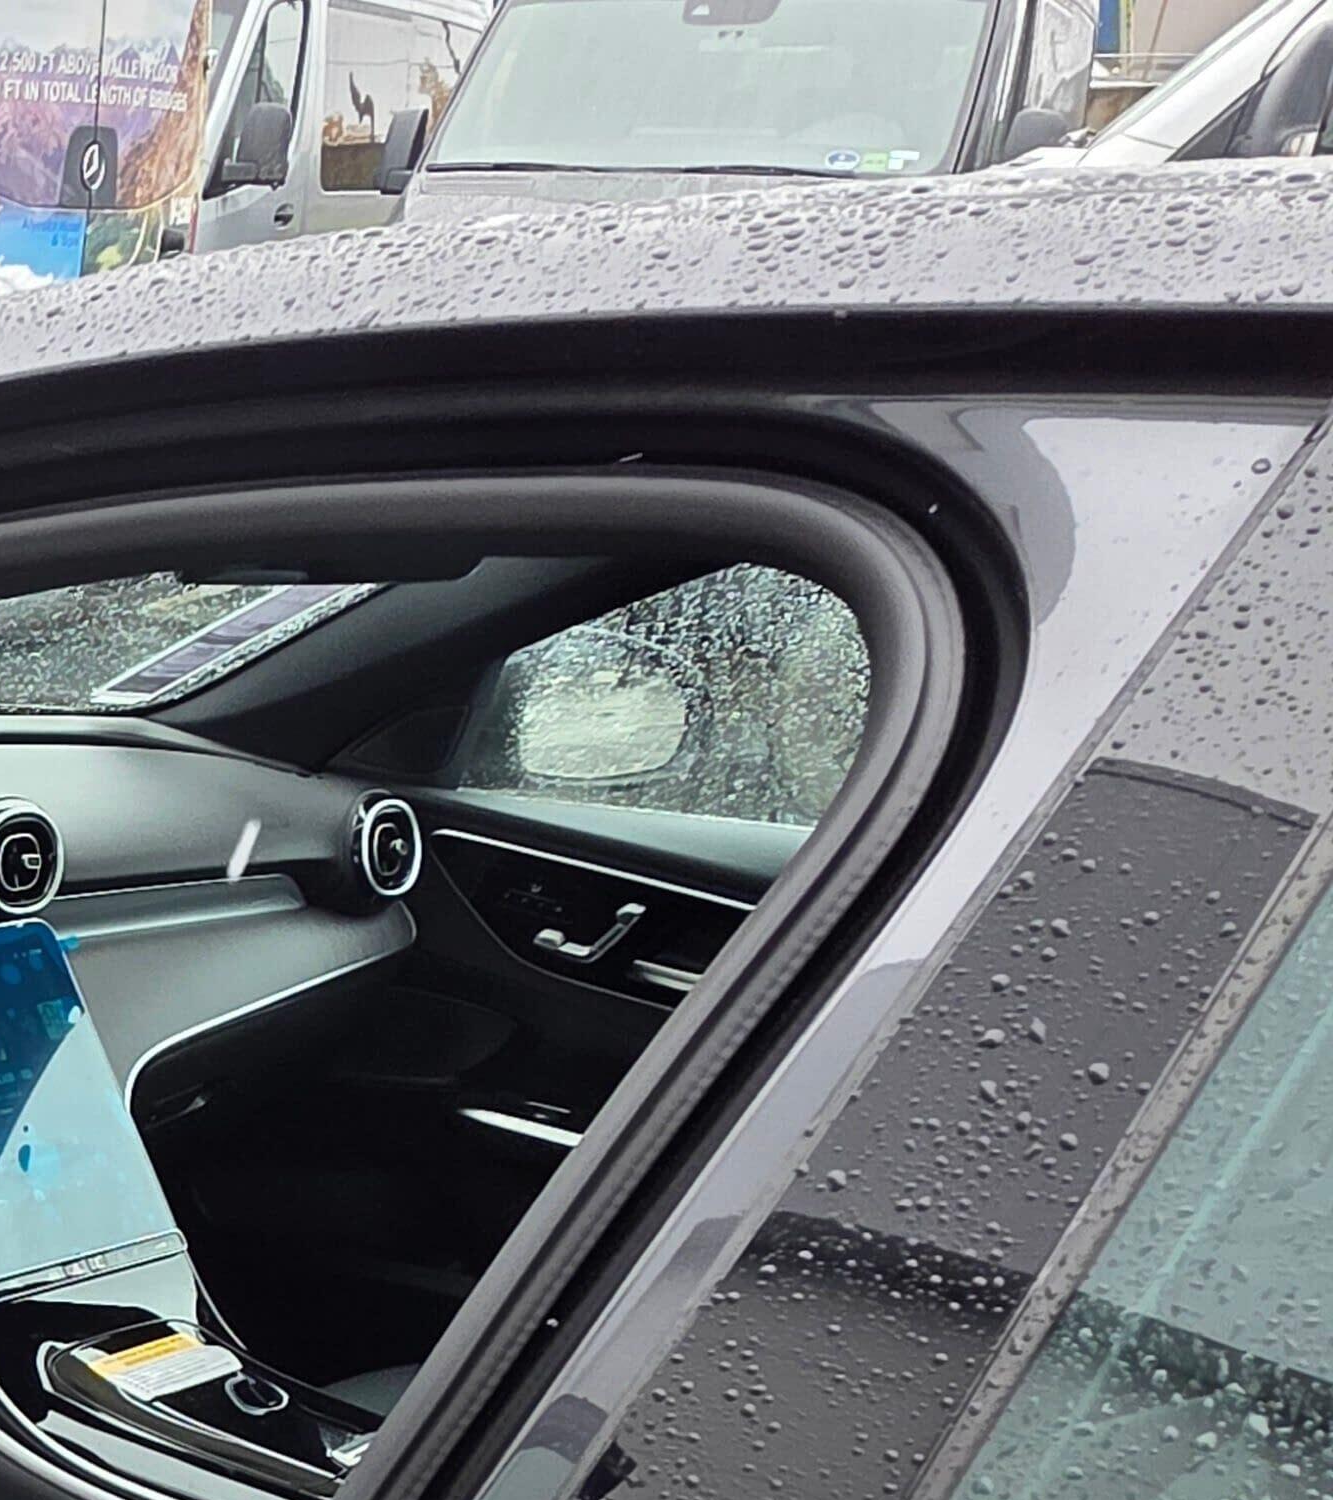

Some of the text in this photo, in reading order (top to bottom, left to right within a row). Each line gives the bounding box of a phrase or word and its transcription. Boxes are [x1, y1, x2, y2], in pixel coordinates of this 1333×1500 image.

[39, 53, 55, 73] FT
[4, 79, 23, 100] FT
[42, 80, 82, 104] TOTAL
[83, 83, 131, 106] LENGTH
